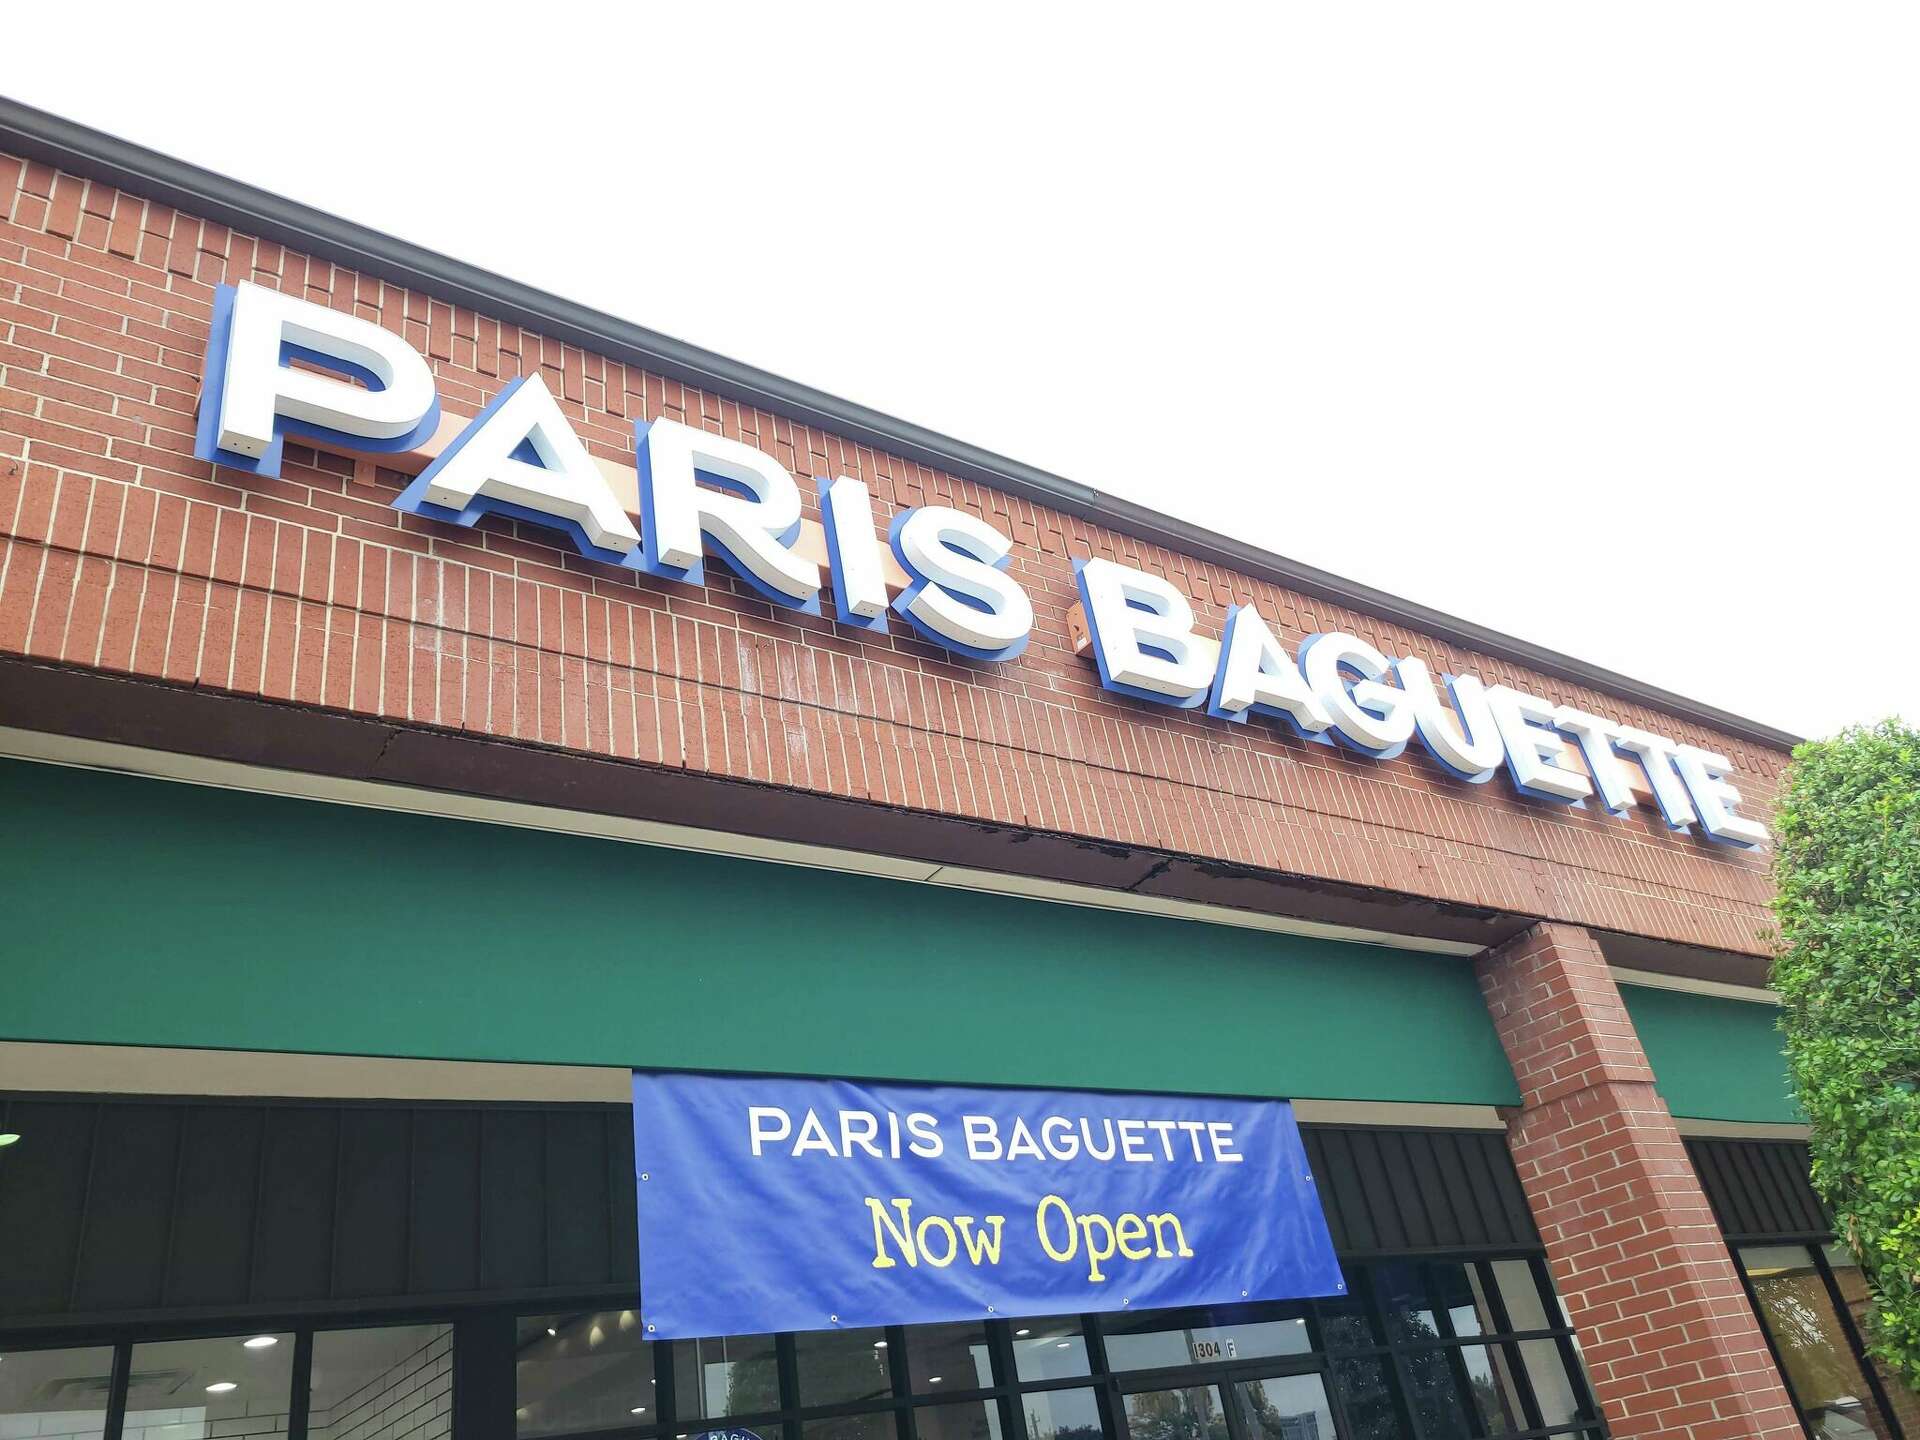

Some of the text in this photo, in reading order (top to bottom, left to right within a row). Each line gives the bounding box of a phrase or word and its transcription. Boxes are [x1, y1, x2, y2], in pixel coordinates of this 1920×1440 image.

[197, 280, 1768, 851] PARIS BAGUETTE
[748, 1106, 1244, 1162] PARIS BAGUETTE
[864, 1194, 1193, 1281] Now Open
[1193, 1341, 1221, 1358] 1304
